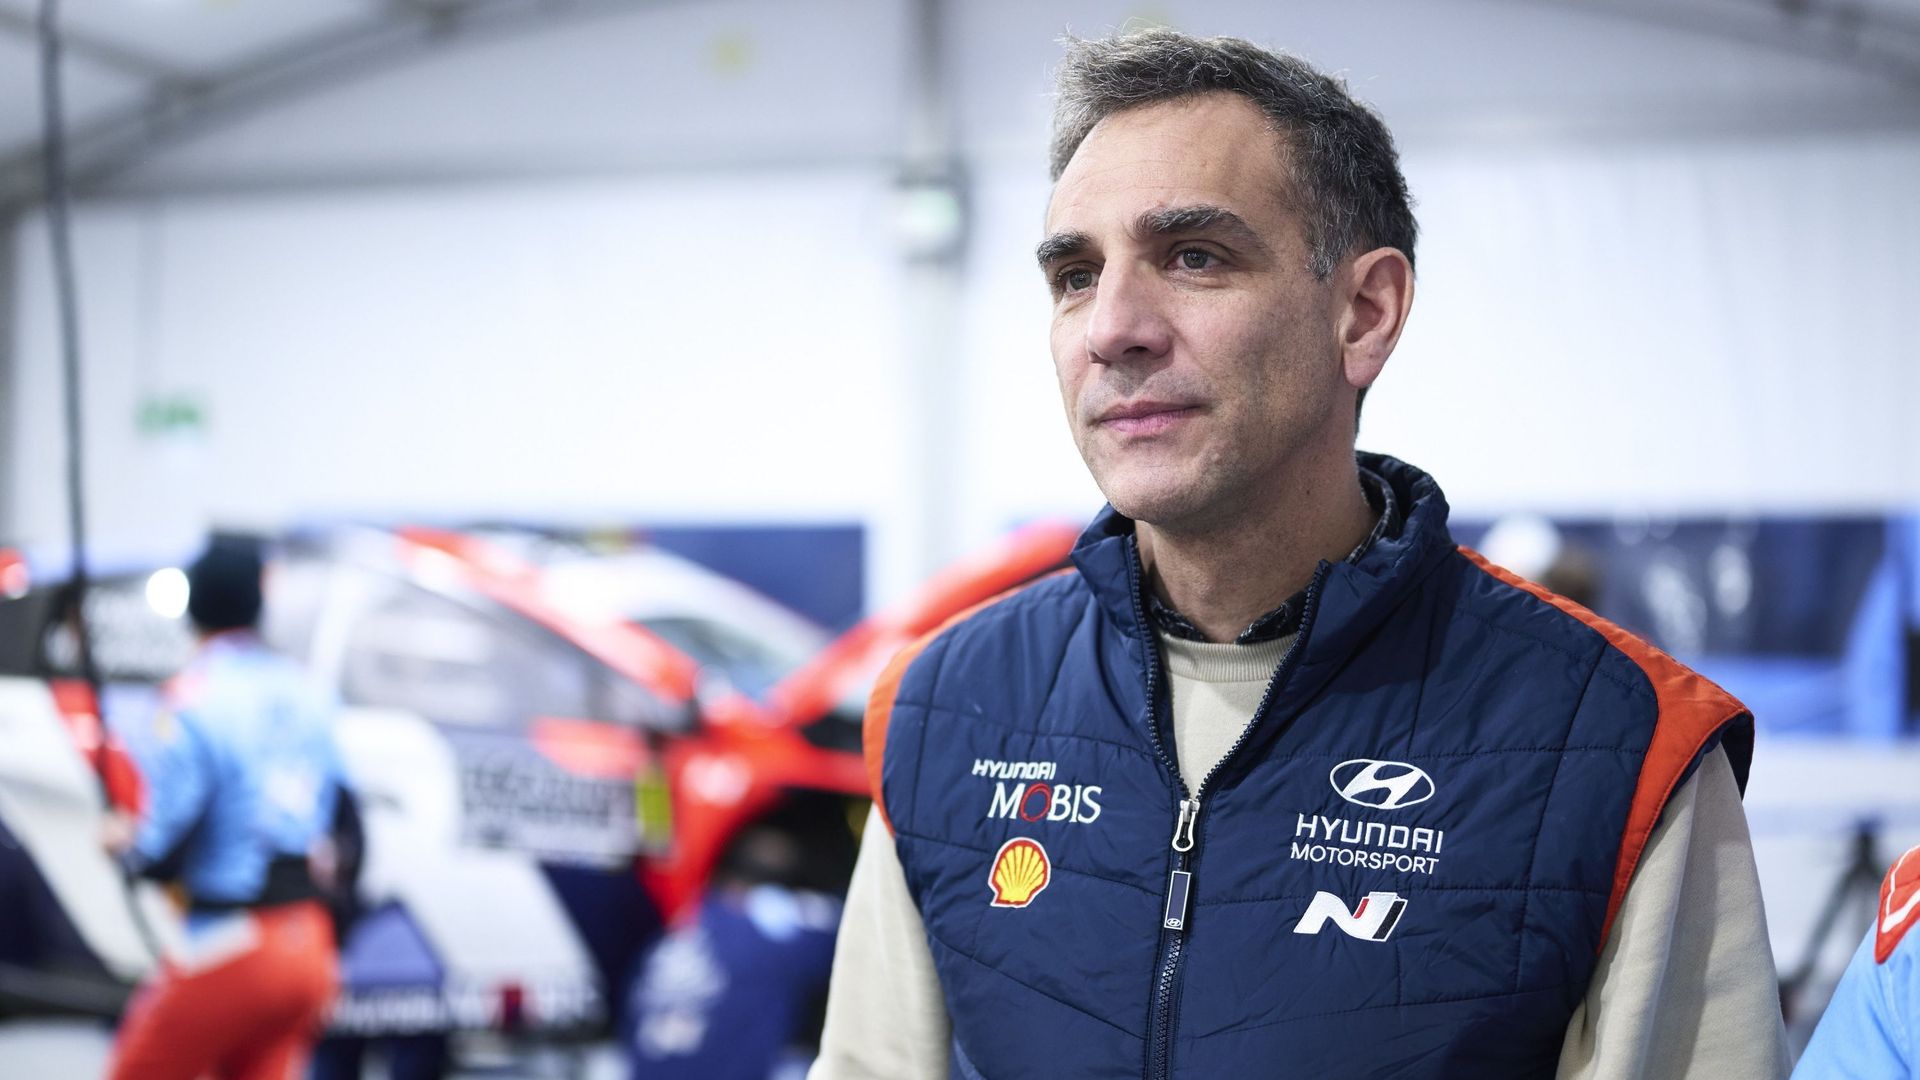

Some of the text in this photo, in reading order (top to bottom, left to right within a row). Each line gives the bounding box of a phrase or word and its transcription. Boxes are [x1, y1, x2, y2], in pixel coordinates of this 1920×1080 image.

[971, 758, 1057, 780] HYUNDAI
[987, 781, 1103, 824] MOBIS
[1295, 812, 1444, 854] HYUNDAI
[1290, 841, 1440, 875] MOTORSPORT
